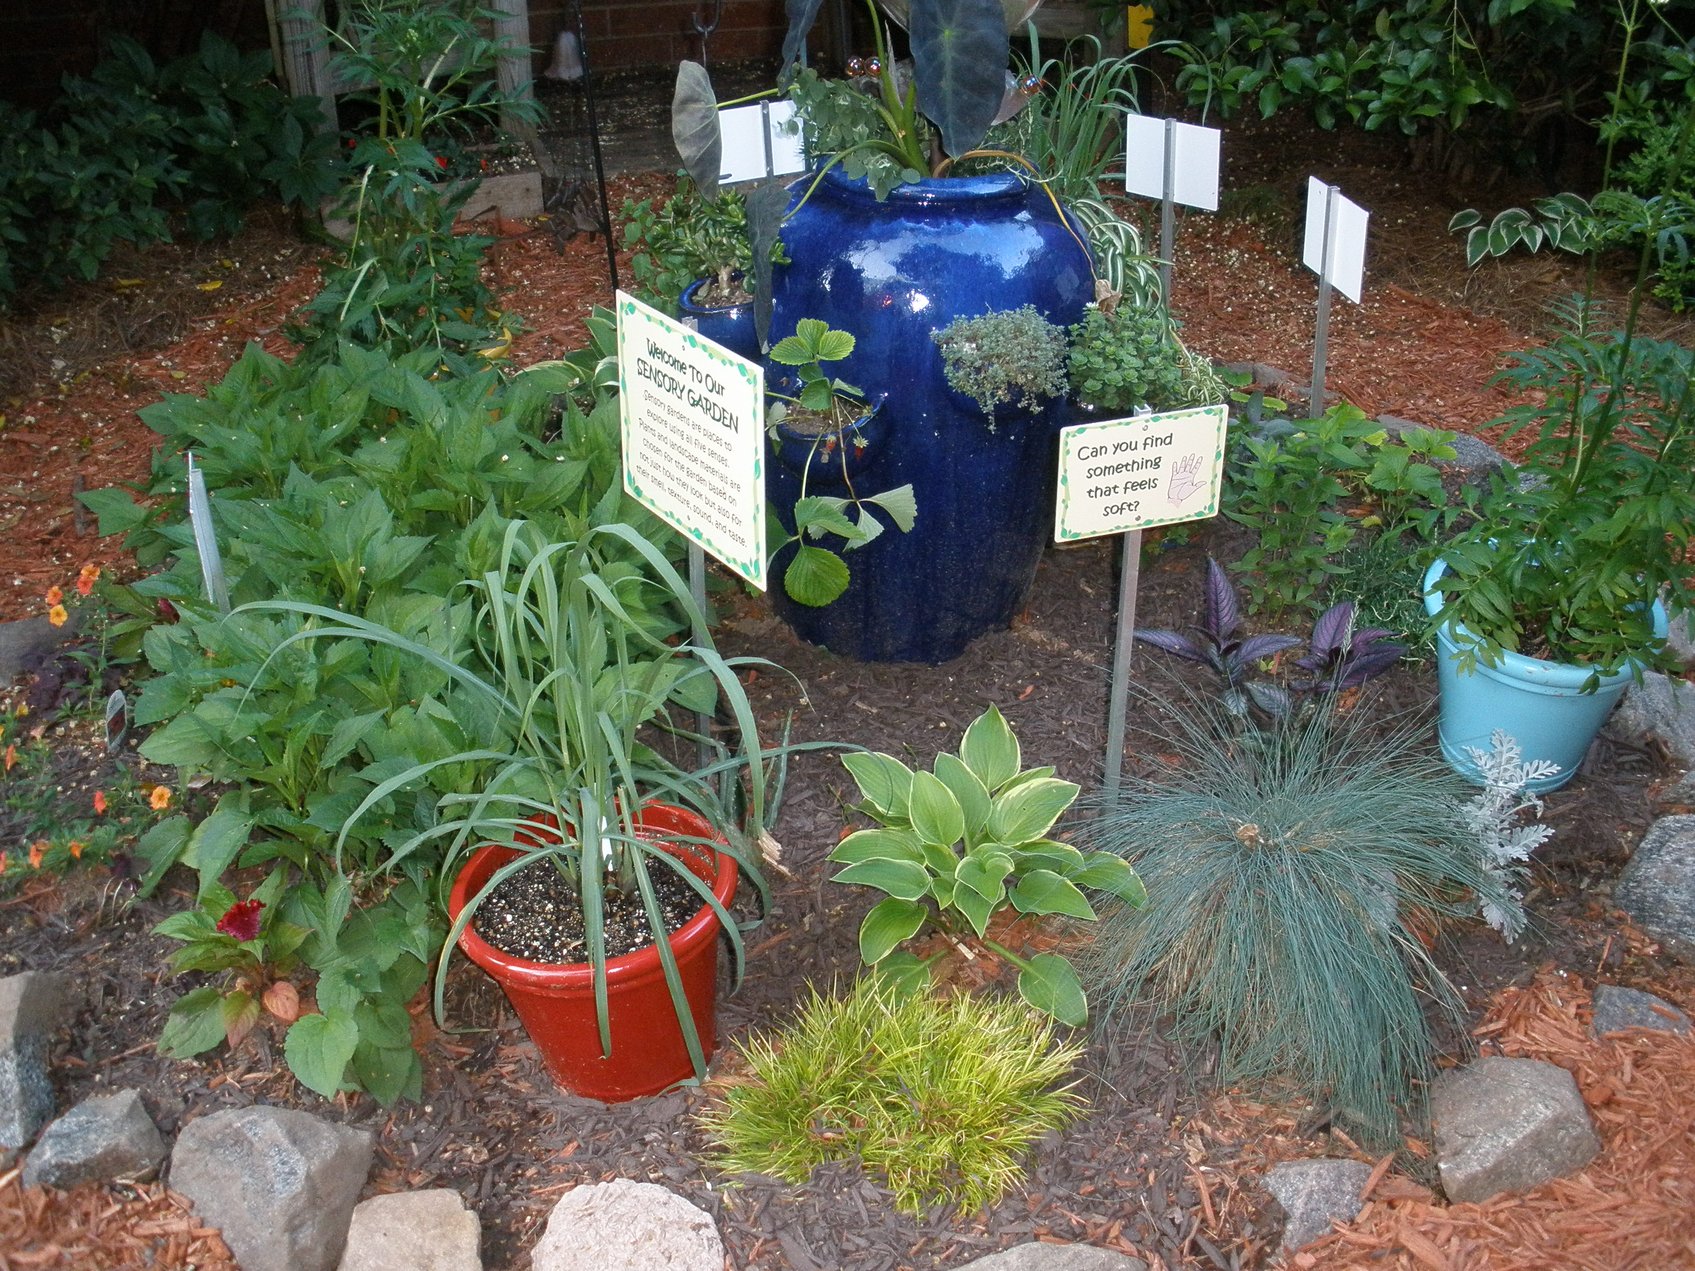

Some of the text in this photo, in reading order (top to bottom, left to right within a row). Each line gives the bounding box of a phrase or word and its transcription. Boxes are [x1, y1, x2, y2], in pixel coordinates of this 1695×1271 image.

[637, 358, 738, 434] SENSORY GARDEN
[647, 338, 725, 396] Welcome To Our
[644, 390, 732, 451] Sensory gardens are places to
[647, 409, 667, 428] explore
[669, 423, 684, 440] using
[694, 439, 706, 453] five
[708, 448, 729, 468] senses.
[1077, 433, 1173, 460] Can you find
[639, 418, 740, 492] Plants and landscape materials are
[643, 438, 736, 507] chosen for the garden based on
[1086, 456, 1162, 478] something
[637, 465, 649, 478] their
[715, 520, 726, 533] and
[729, 530, 747, 547] taste.
[640, 452, 742, 526] not just how they look but also for
[1086, 478, 1158, 498] that feels
[1103, 501, 1140, 517] soft?
